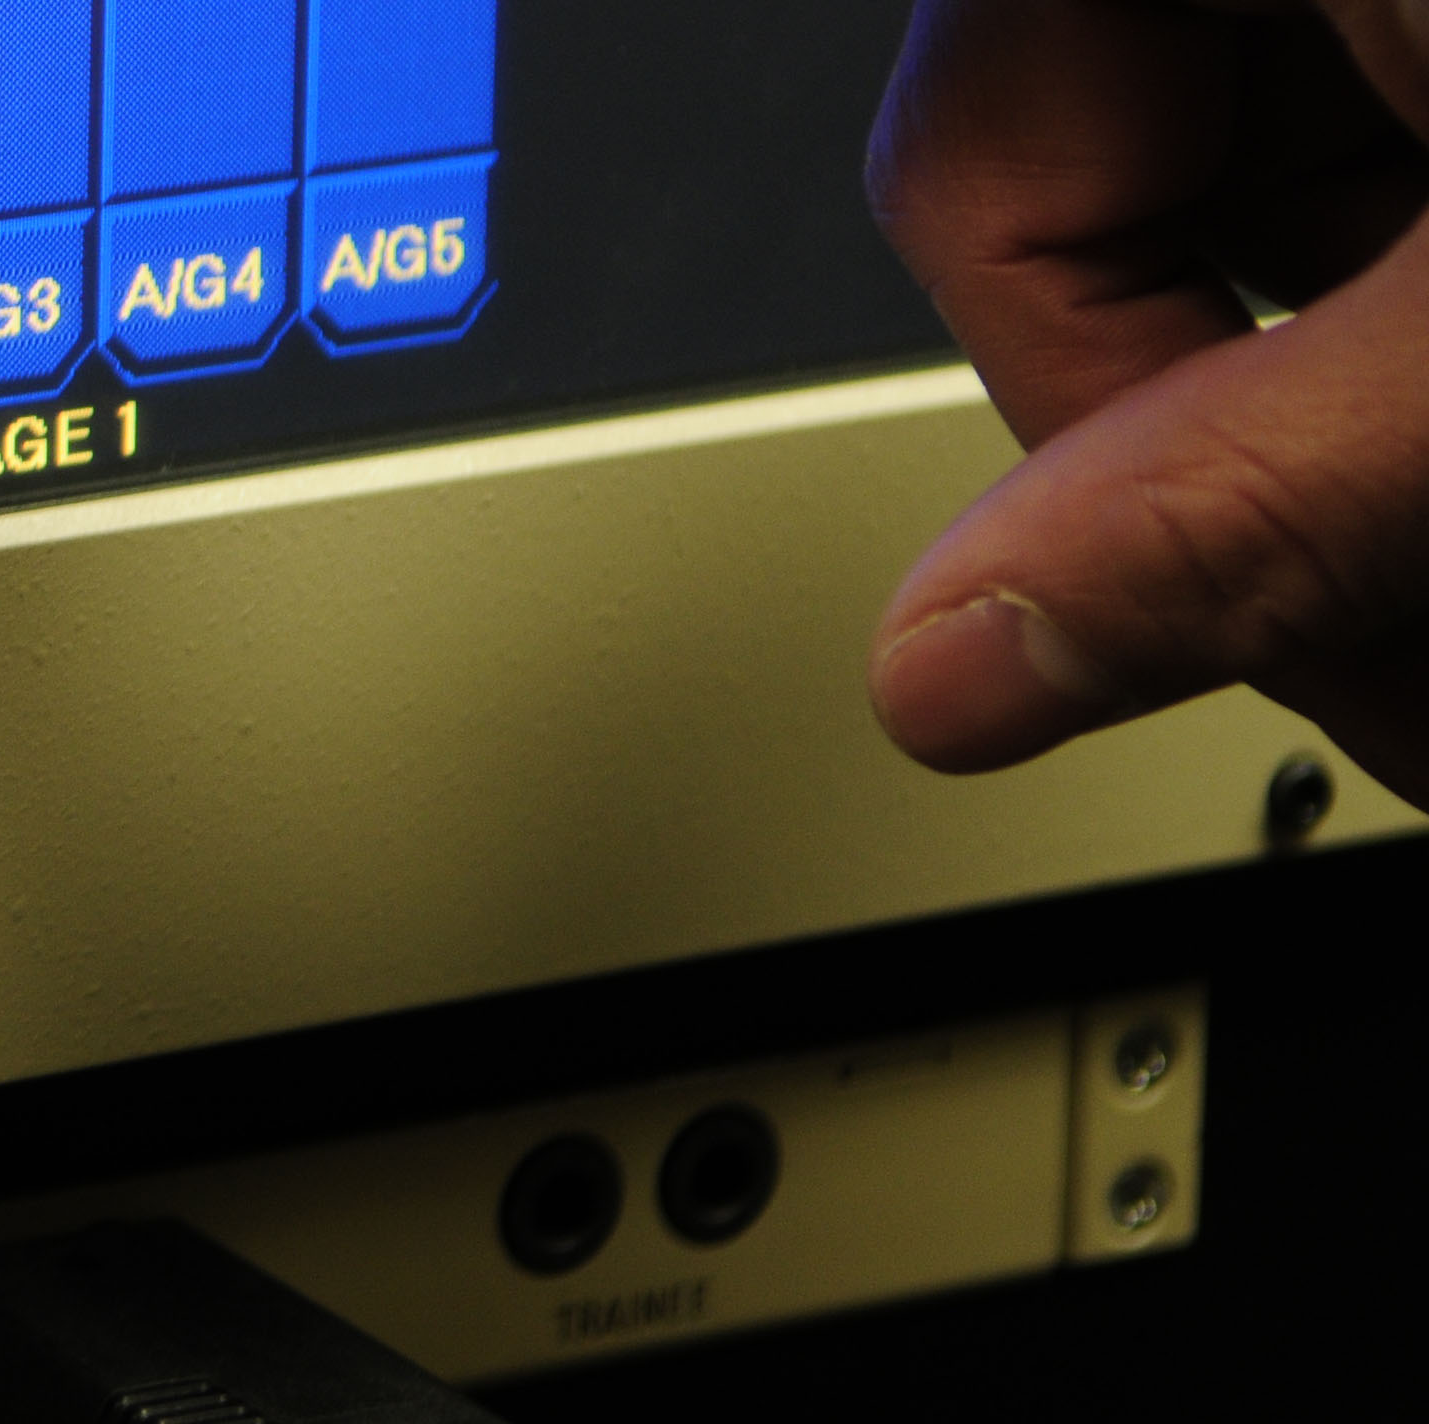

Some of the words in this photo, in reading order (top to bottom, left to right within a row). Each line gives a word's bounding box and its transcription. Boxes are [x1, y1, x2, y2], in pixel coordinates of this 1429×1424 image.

[118, 246, 265, 321] A/G4
[320, 217, 465, 292] A/G5
[117, 399, 138, 457] 1
